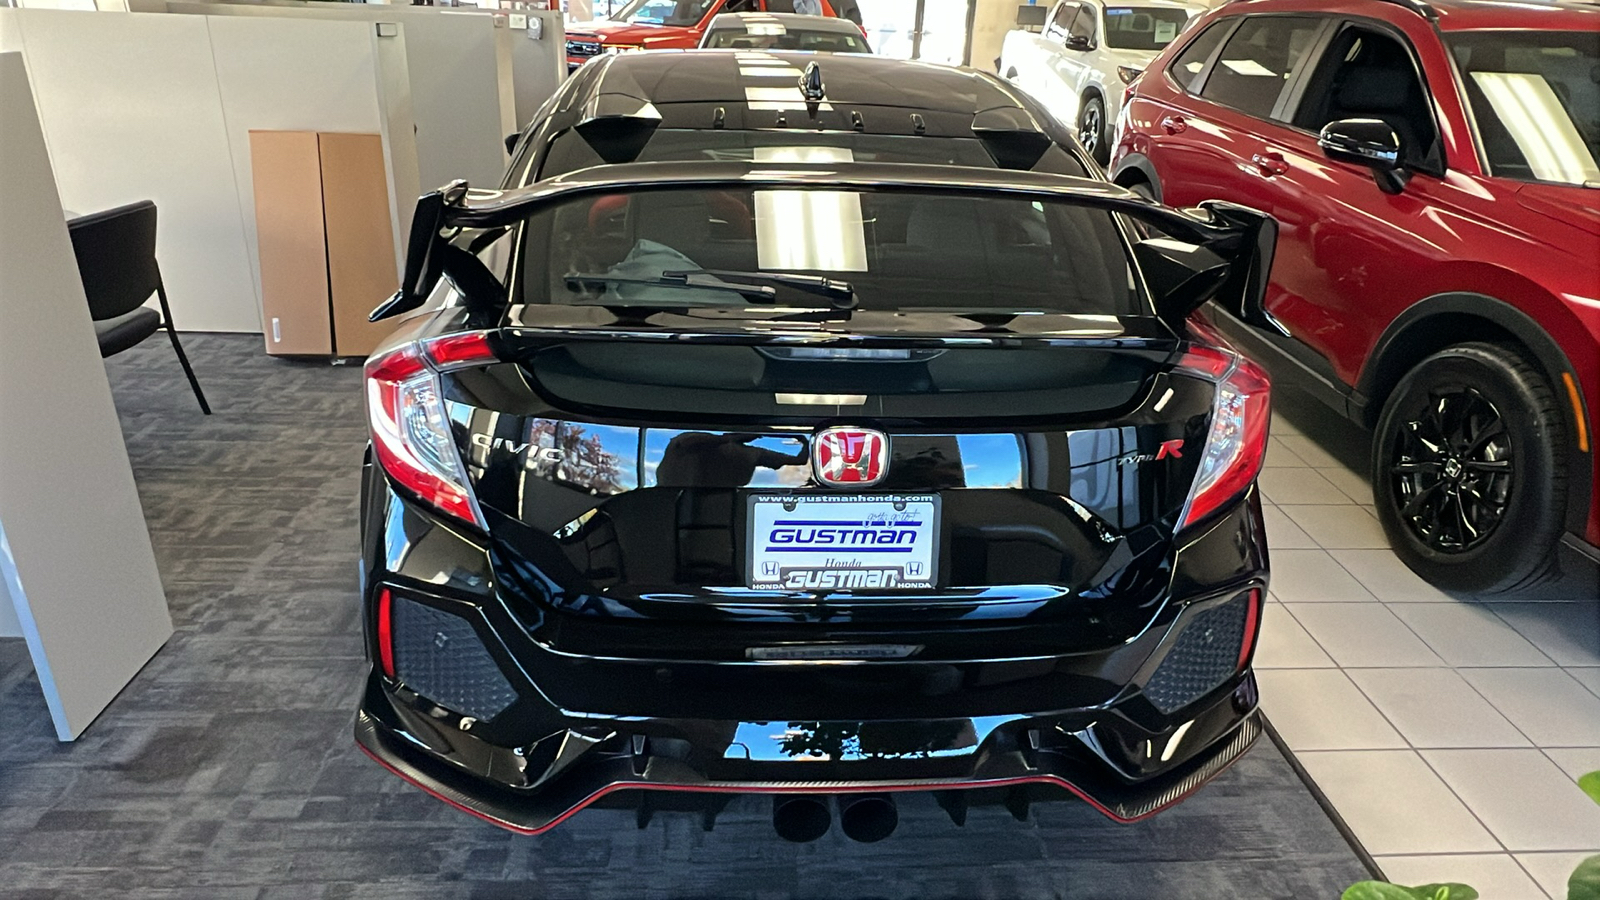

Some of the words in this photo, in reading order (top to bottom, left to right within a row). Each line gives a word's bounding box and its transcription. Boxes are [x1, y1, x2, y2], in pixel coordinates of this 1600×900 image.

[472, 433, 562, 462] CIVIC
[1155, 439, 1184, 460] R
[758, 495, 933, 503] www.gustmanhonda.com
[825, 558, 862, 567] Honda
